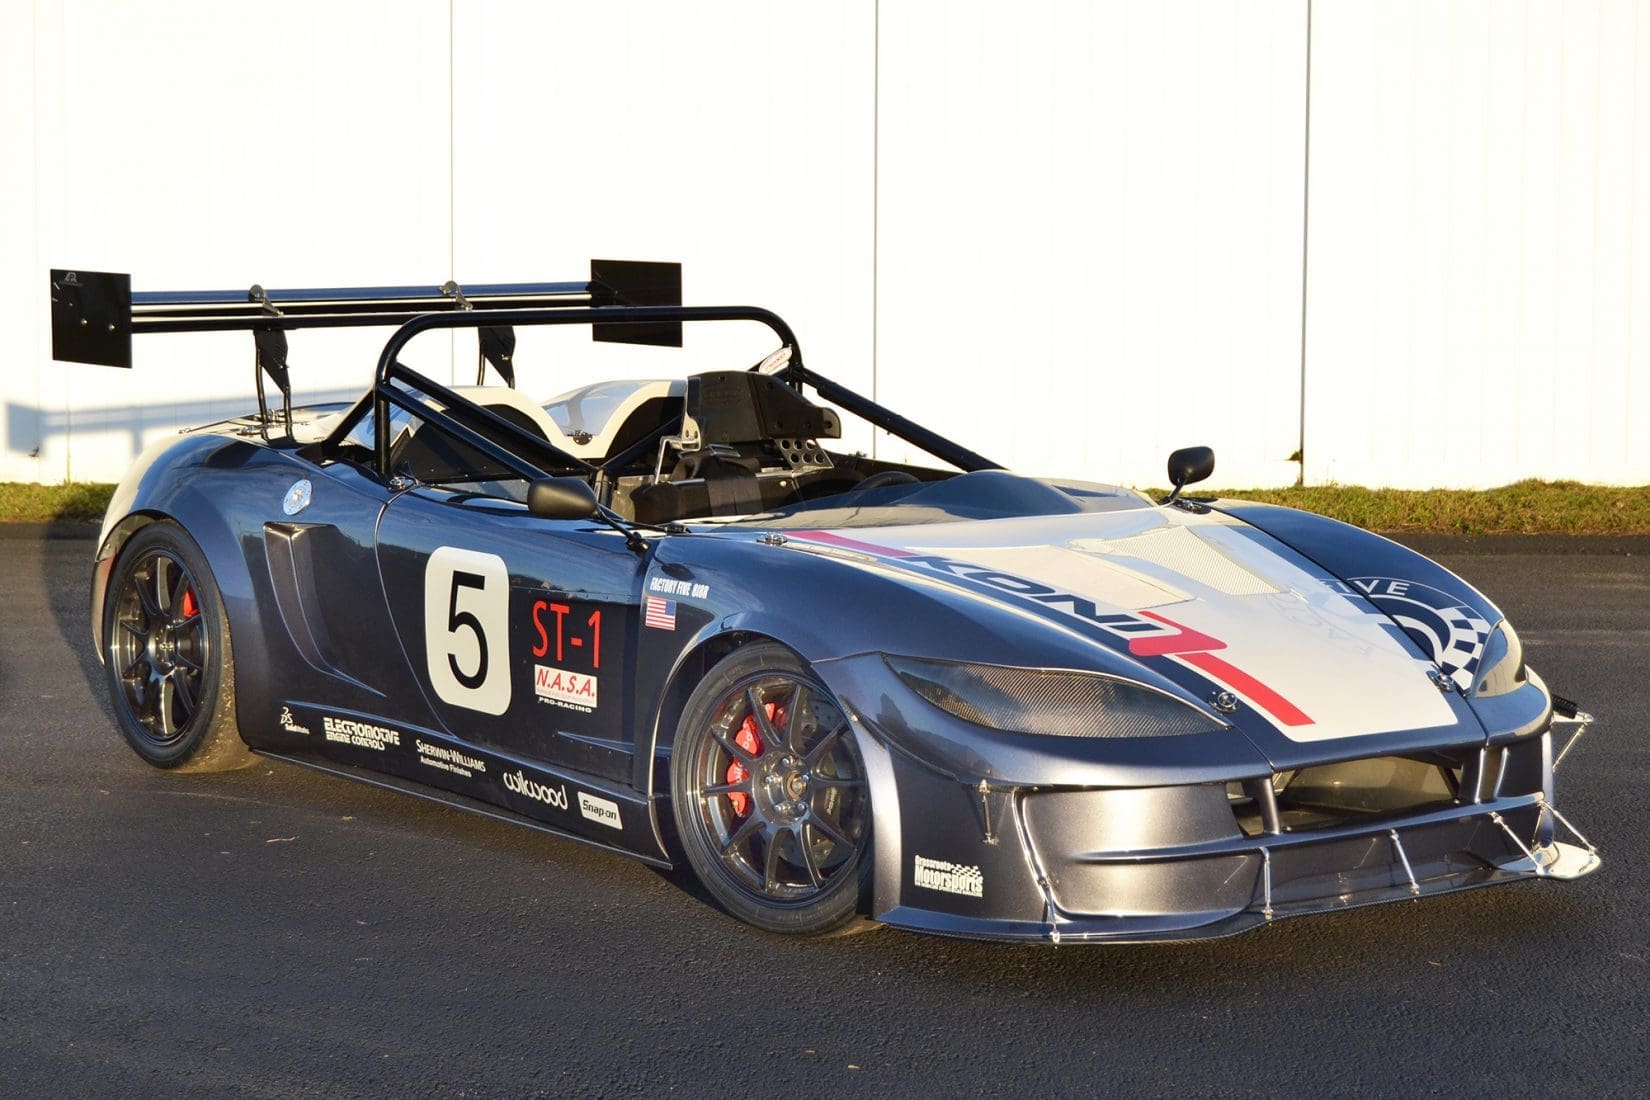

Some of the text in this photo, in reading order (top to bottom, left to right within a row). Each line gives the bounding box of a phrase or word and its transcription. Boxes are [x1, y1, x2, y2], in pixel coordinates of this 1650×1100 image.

[650, 577, 678, 595] FACTORY
[676, 581, 692, 596] FIVE
[894, 556, 1163, 632] KONI
[447, 569, 489, 690] 5
[532, 600, 601, 669] ST-1
[536, 668, 596, 697] N.A.S.A.
[537, 696, 593, 714] PRO-RACING
[323, 717, 401, 746] ELECTROMOTIVE
[351, 735, 386, 751] CONTROLS
[503, 770, 568, 811] wilwood
[582, 799, 617, 821] Snap-on
[914, 865, 984, 894] Motorsports
